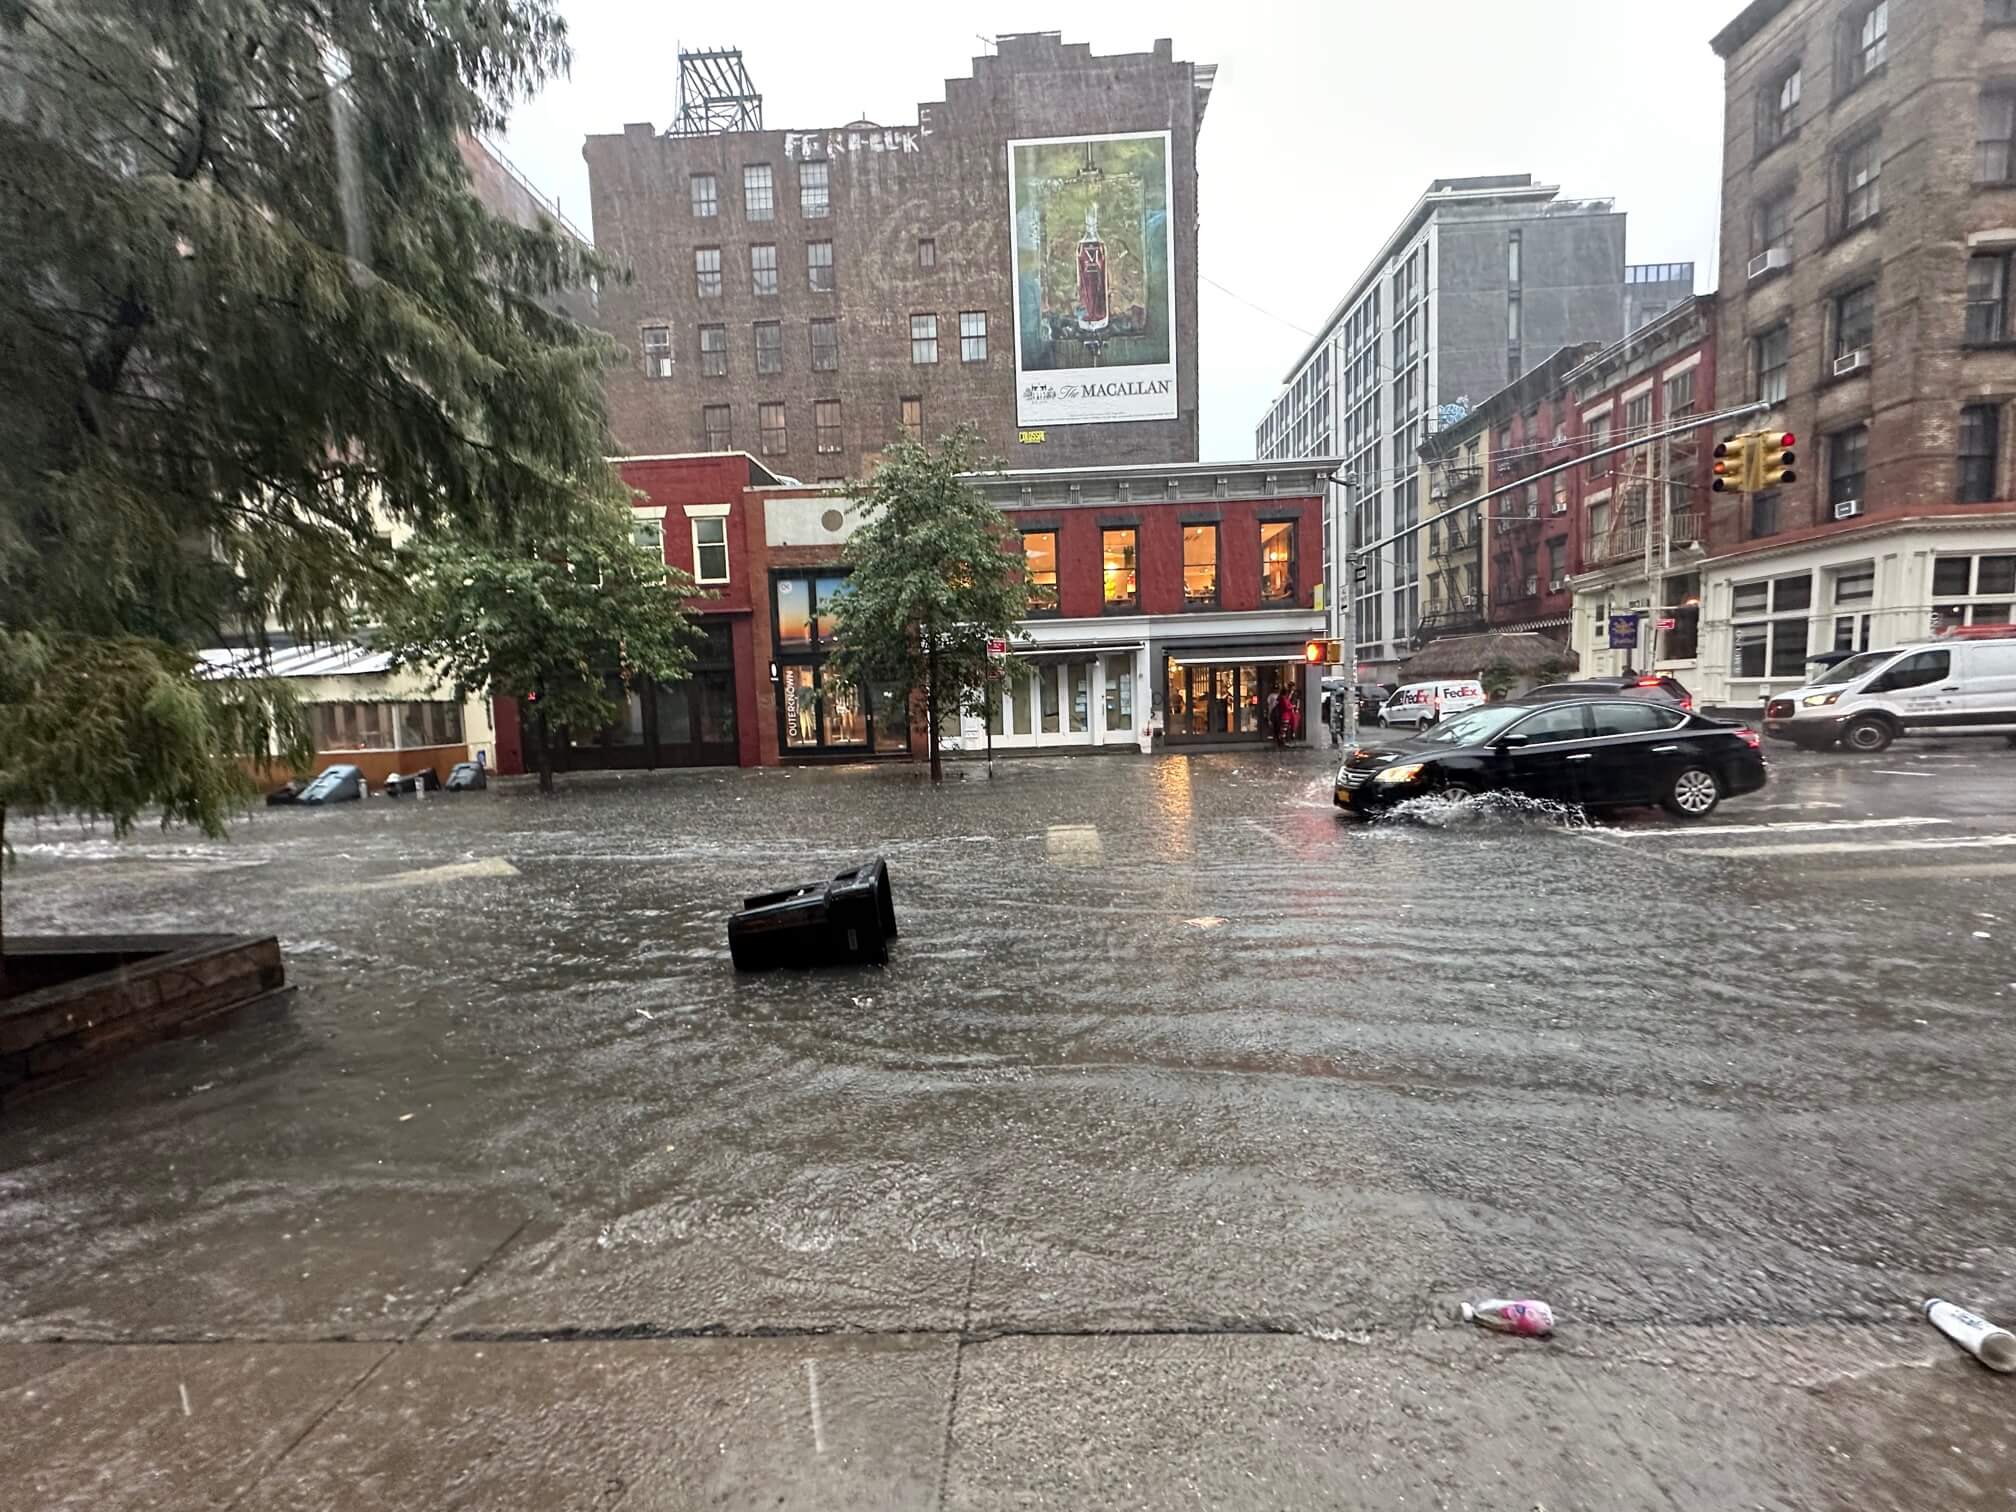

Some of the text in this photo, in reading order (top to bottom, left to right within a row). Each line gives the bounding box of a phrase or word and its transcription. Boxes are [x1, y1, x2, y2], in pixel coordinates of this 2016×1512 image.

[1057, 380, 1172, 400] The MACALLAN
[1405, 689, 1429, 704] FedEx
[1443, 686, 1478, 699] FedEx
[785, 670, 797, 736] OUTERKNOWN
